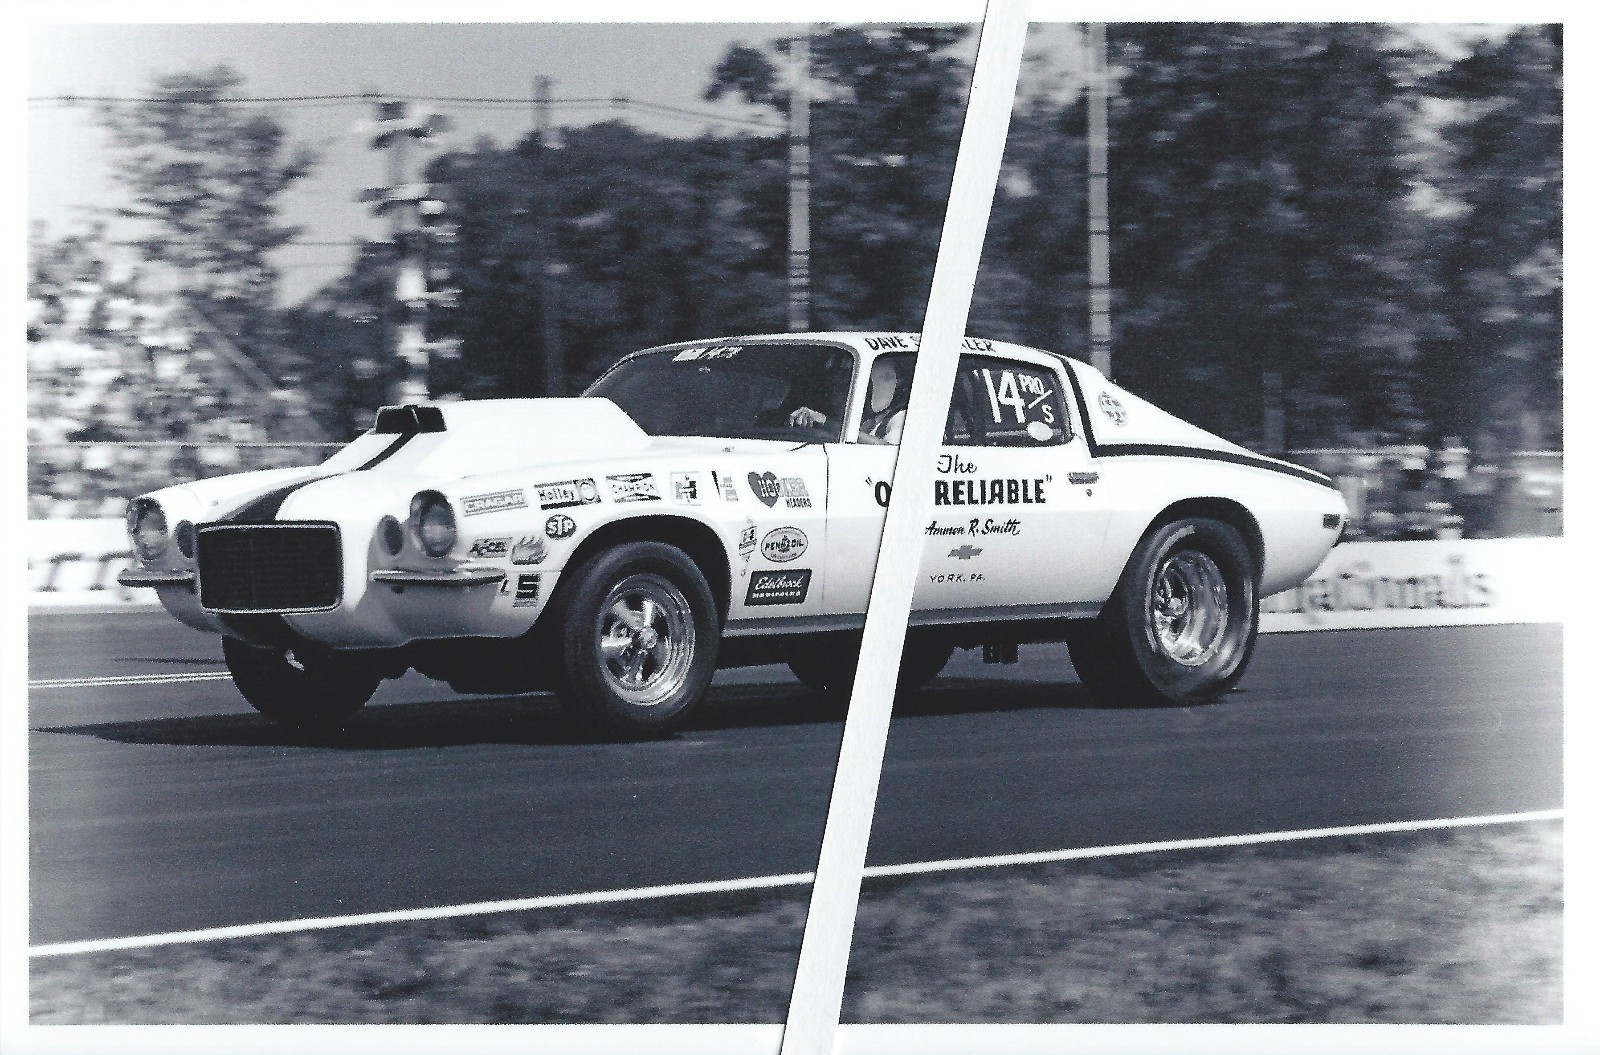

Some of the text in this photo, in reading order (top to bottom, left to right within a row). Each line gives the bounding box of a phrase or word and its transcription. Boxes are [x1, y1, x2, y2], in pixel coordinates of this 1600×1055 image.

[864, 335, 909, 351] DAVE
[936, 453, 978, 474] The
[538, 487, 576, 502] Holley
[545, 515, 575, 536] STP
[924, 519, 966, 536] Ammon
[980, 517, 1022, 536] Smith
